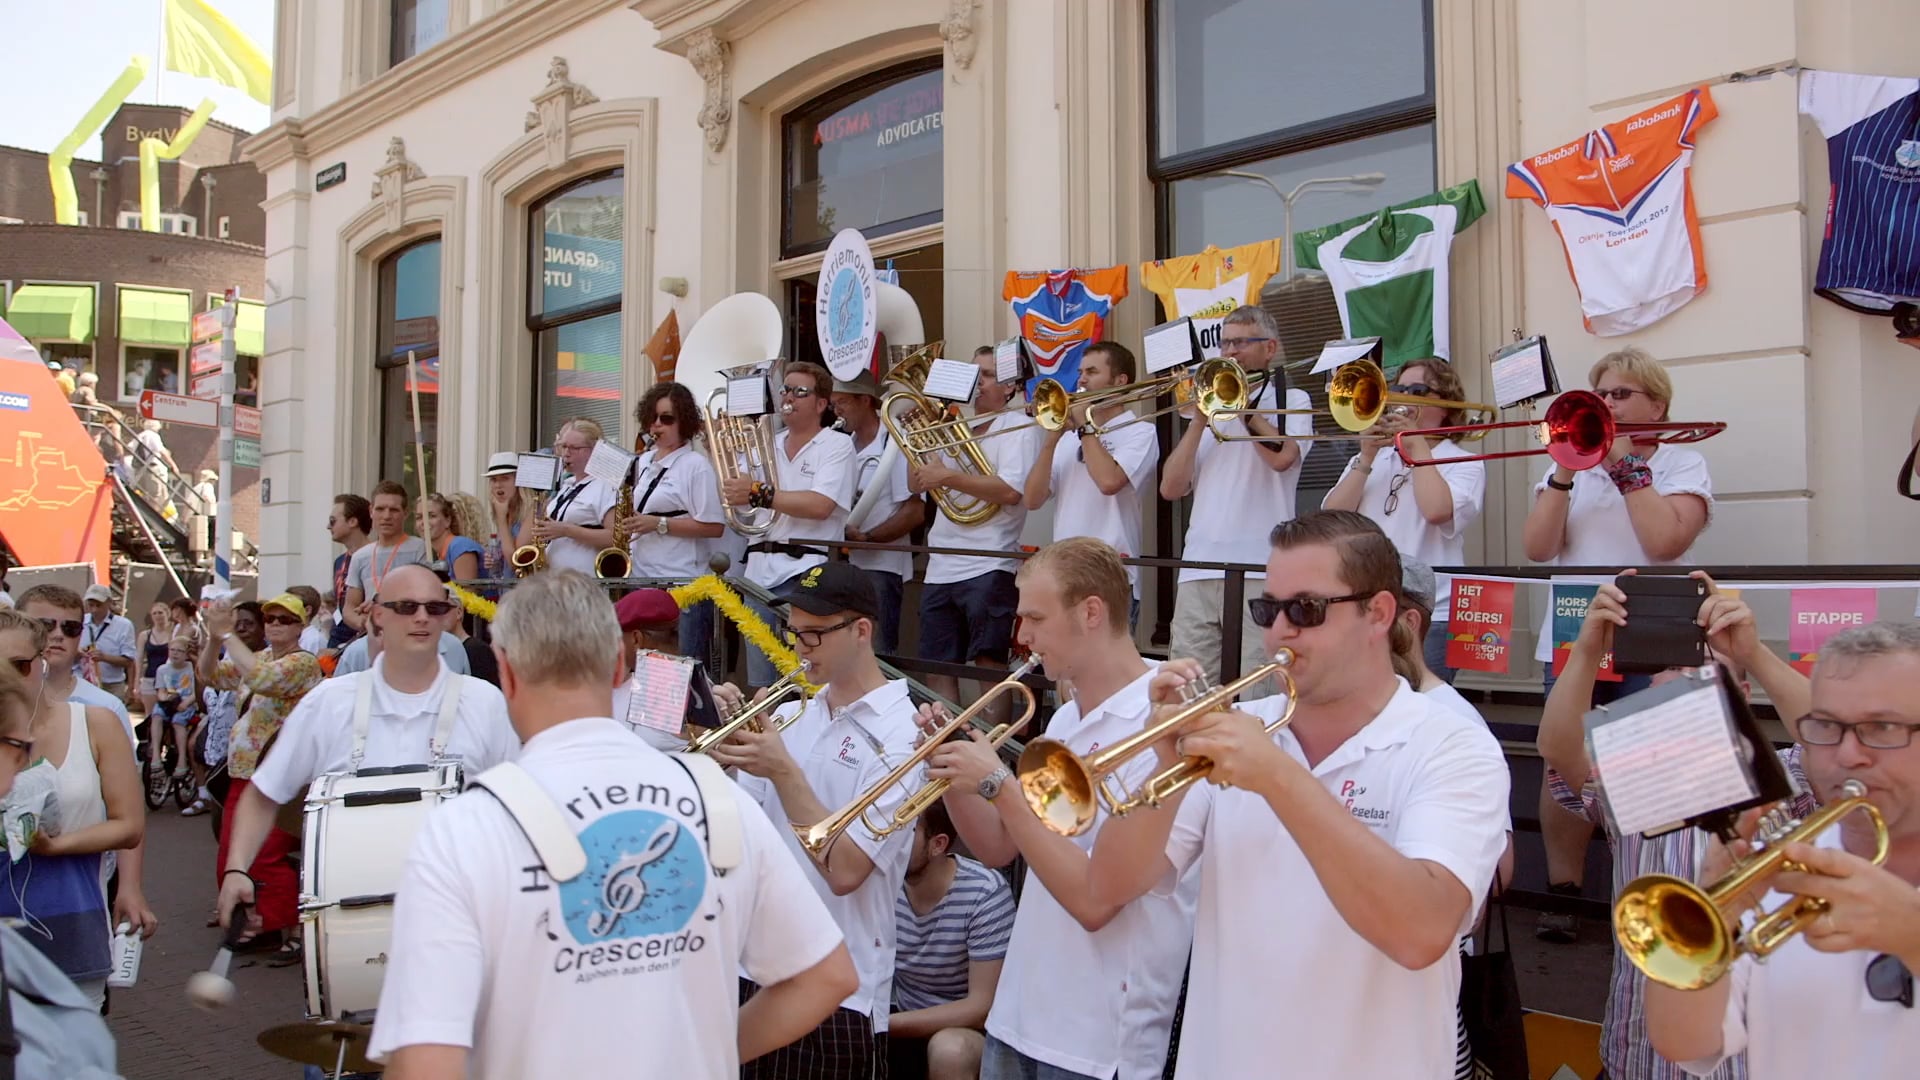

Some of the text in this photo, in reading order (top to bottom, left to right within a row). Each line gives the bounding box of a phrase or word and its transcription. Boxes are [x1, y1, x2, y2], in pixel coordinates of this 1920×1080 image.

[1605, 228, 1649, 248] Londen
[1200, 322, 1222, 350] ott
[828, 335, 869, 363] Crescendo
[0, 394, 29, 408] .COM
[154, 395, 188, 407] Centrum
[1458, 584, 1483, 597] HET
[1457, 597, 1470, 609] IS
[1556, 597, 1588, 607] HORS
[1456, 611, 1503, 625] KOERS!
[1797, 612, 1863, 625] ETAPPE
[1463, 643, 1505, 655] UTRECHT
[1475, 651, 1496, 662] 2015
[647, 961, 670, 972] den
